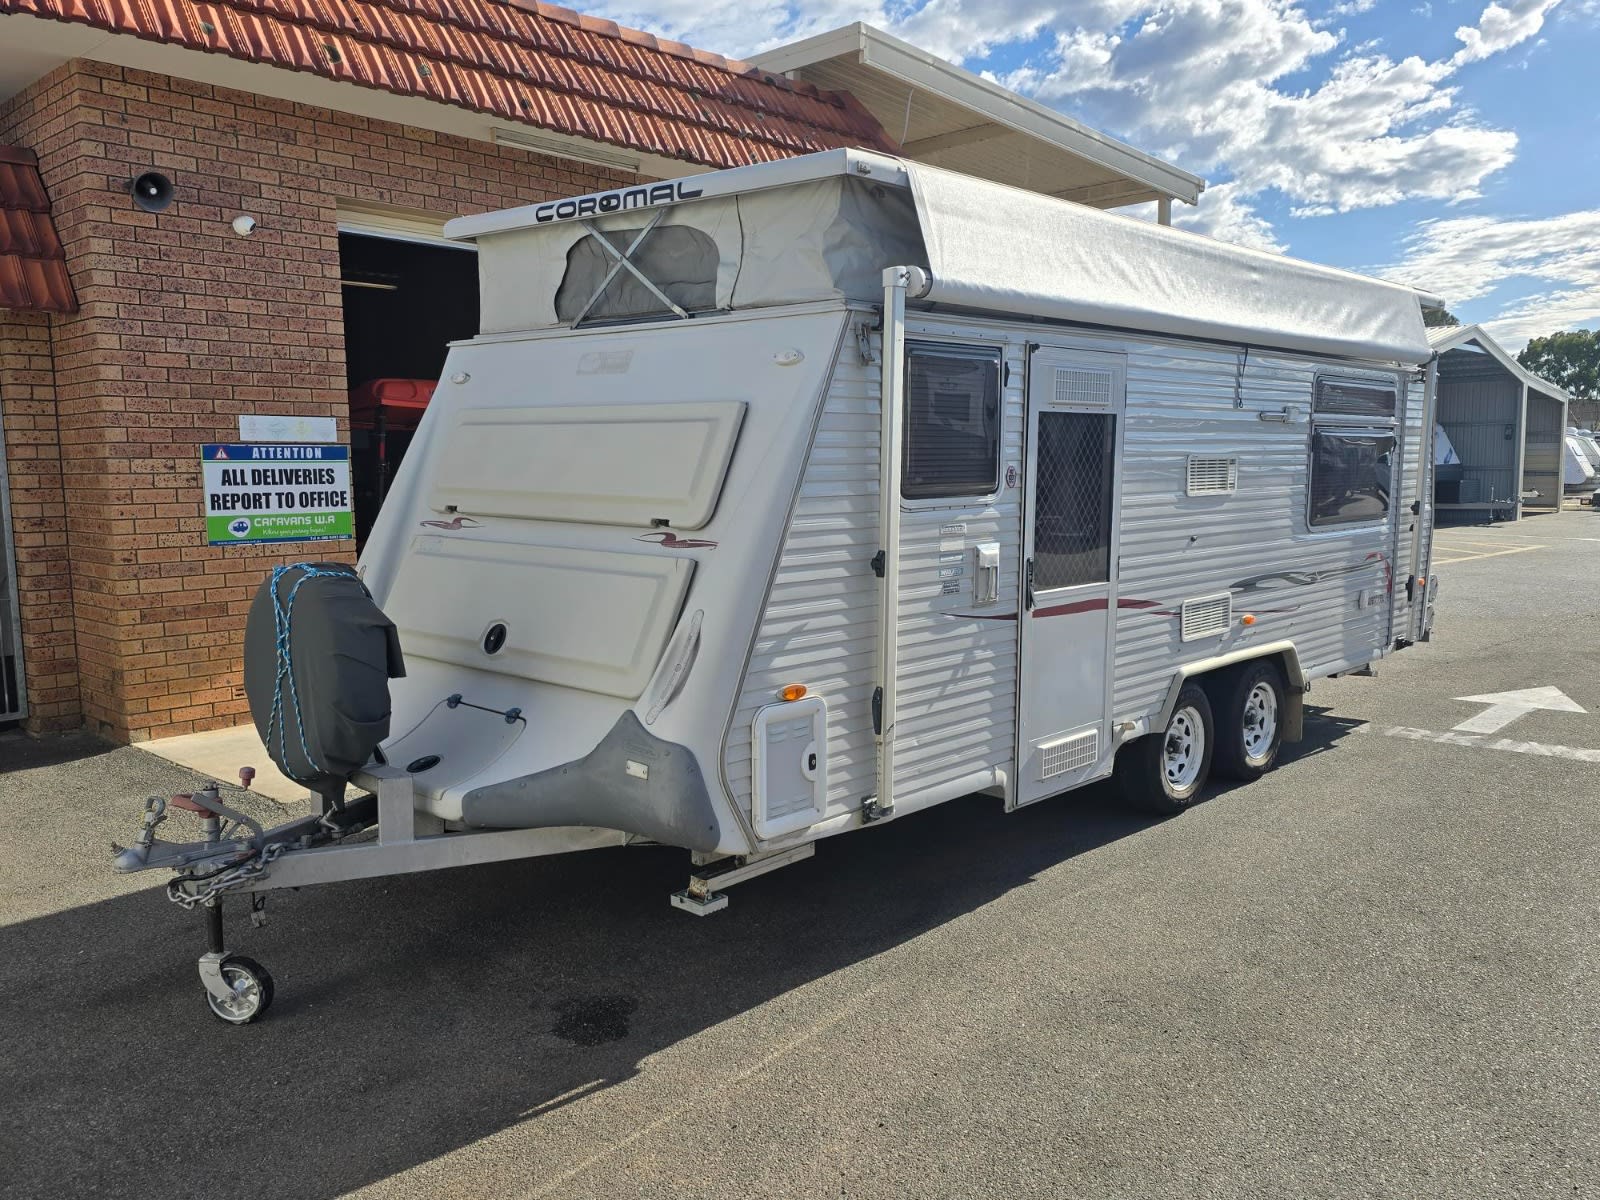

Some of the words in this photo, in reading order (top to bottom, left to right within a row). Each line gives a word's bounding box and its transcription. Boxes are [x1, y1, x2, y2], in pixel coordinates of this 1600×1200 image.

[536, 182, 703, 222] COROMAL
[252, 447, 322, 459] ATTENTION
[221, 469, 248, 486] ALL
[251, 468, 335, 486] DELIVERIES
[210, 492, 272, 511] REPORT
[275, 492, 294, 509] TO
[299, 490, 347, 508] OFFICE
[254, 516, 311, 527] CARAVANS
